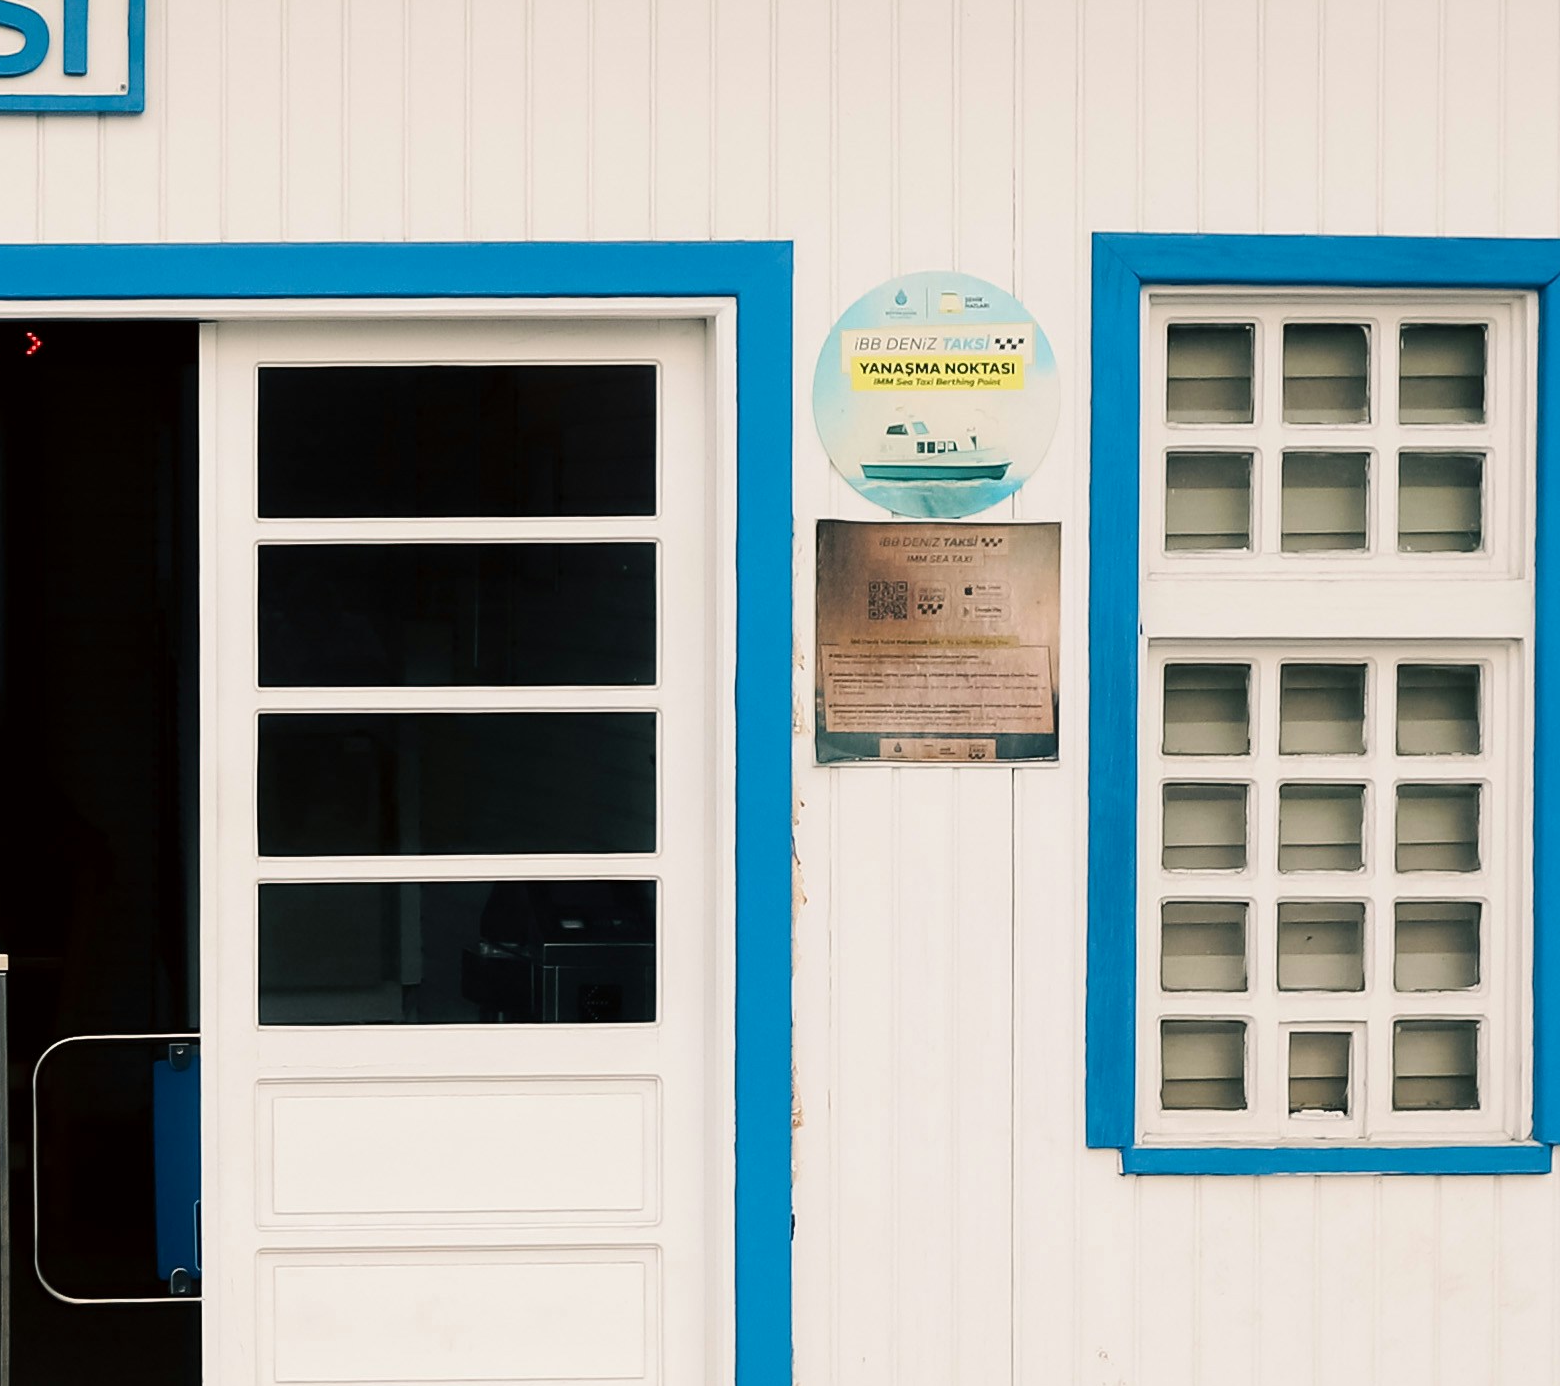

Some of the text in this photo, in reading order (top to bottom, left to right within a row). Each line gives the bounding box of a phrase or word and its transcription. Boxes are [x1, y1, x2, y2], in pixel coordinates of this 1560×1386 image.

[942, 333, 991, 351] TAKSİ
[859, 362, 1015, 377] YANAŞMA NOKTASI
[895, 377, 914, 386] Sea
[915, 377, 934, 386] Taxi
[935, 377, 976, 388] Berthing
[976, 377, 1002, 386] Point
[929, 554, 949, 564] SEA
